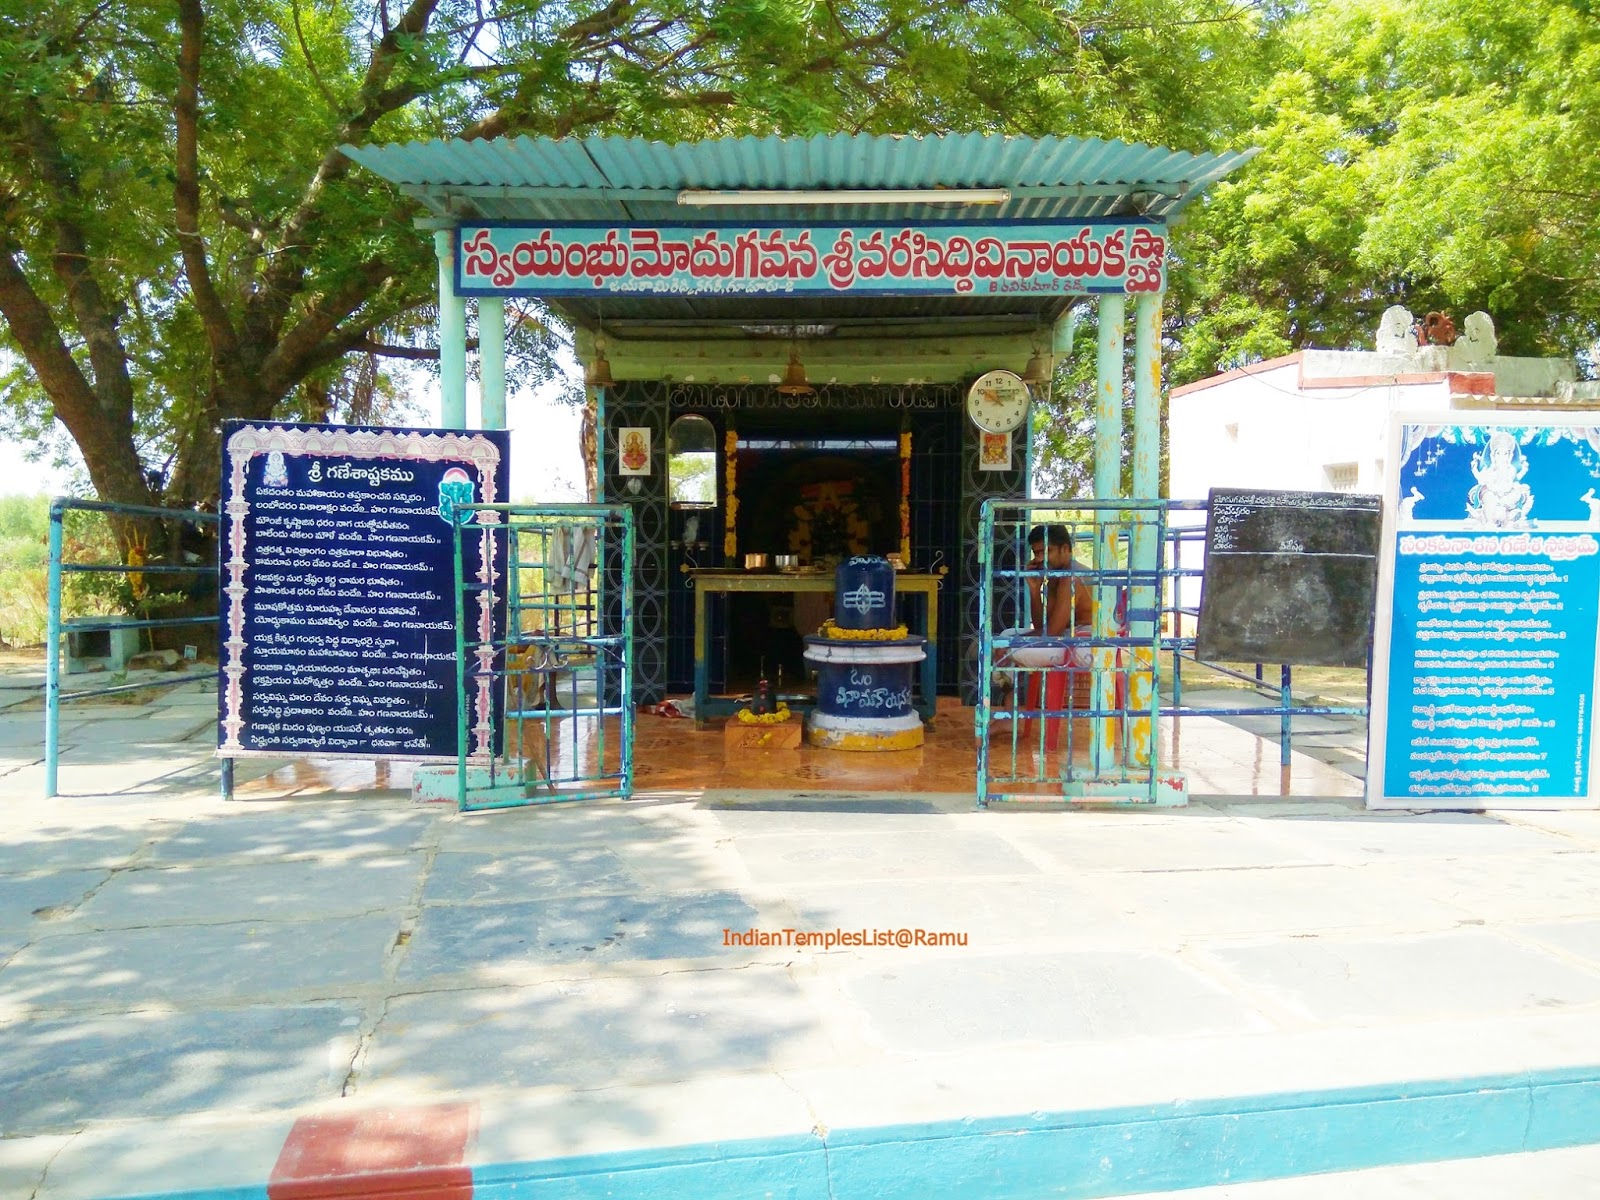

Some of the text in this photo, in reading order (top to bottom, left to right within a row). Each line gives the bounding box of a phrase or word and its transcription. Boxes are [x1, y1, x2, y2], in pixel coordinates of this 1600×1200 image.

[989, 281, 997, 292] B
[307, 461, 414, 486] శ్రీ గణేశాష్టకము
